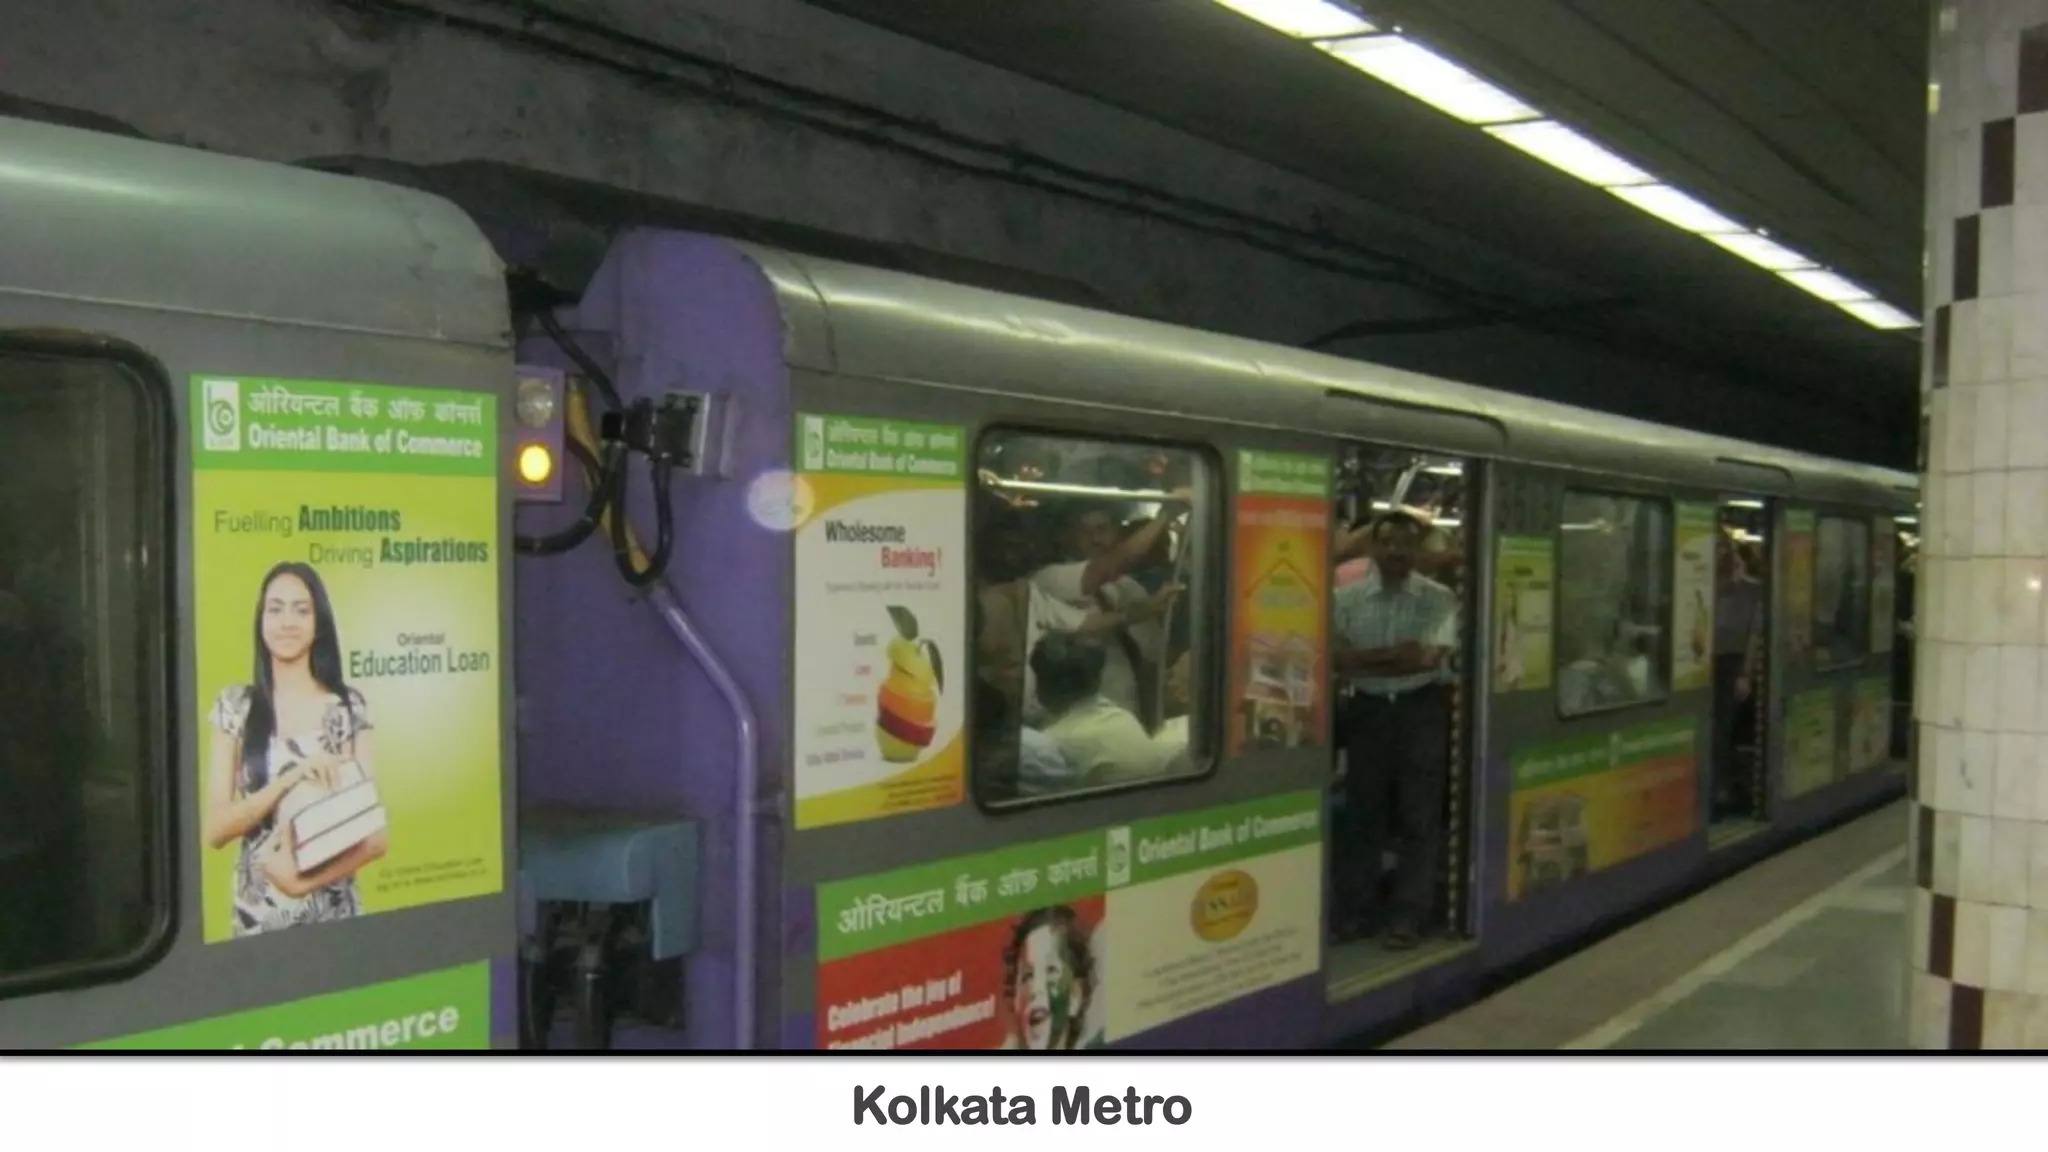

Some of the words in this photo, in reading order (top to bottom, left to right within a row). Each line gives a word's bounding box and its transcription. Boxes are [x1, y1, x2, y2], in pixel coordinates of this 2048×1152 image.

[249, 422, 322, 450] Oriental
[325, 426, 371, 452] Bank
[373, 428, 391, 453] of
[396, 428, 483, 458] Commerce
[214, 510, 293, 537] Fuelling
[298, 505, 402, 532] Ambitions
[825, 519, 906, 543] Wholesome
[308, 542, 373, 567] Driving
[379, 537, 489, 565] Aspirations
[350, 648, 443, 679] Education
[448, 647, 490, 672] Loan
